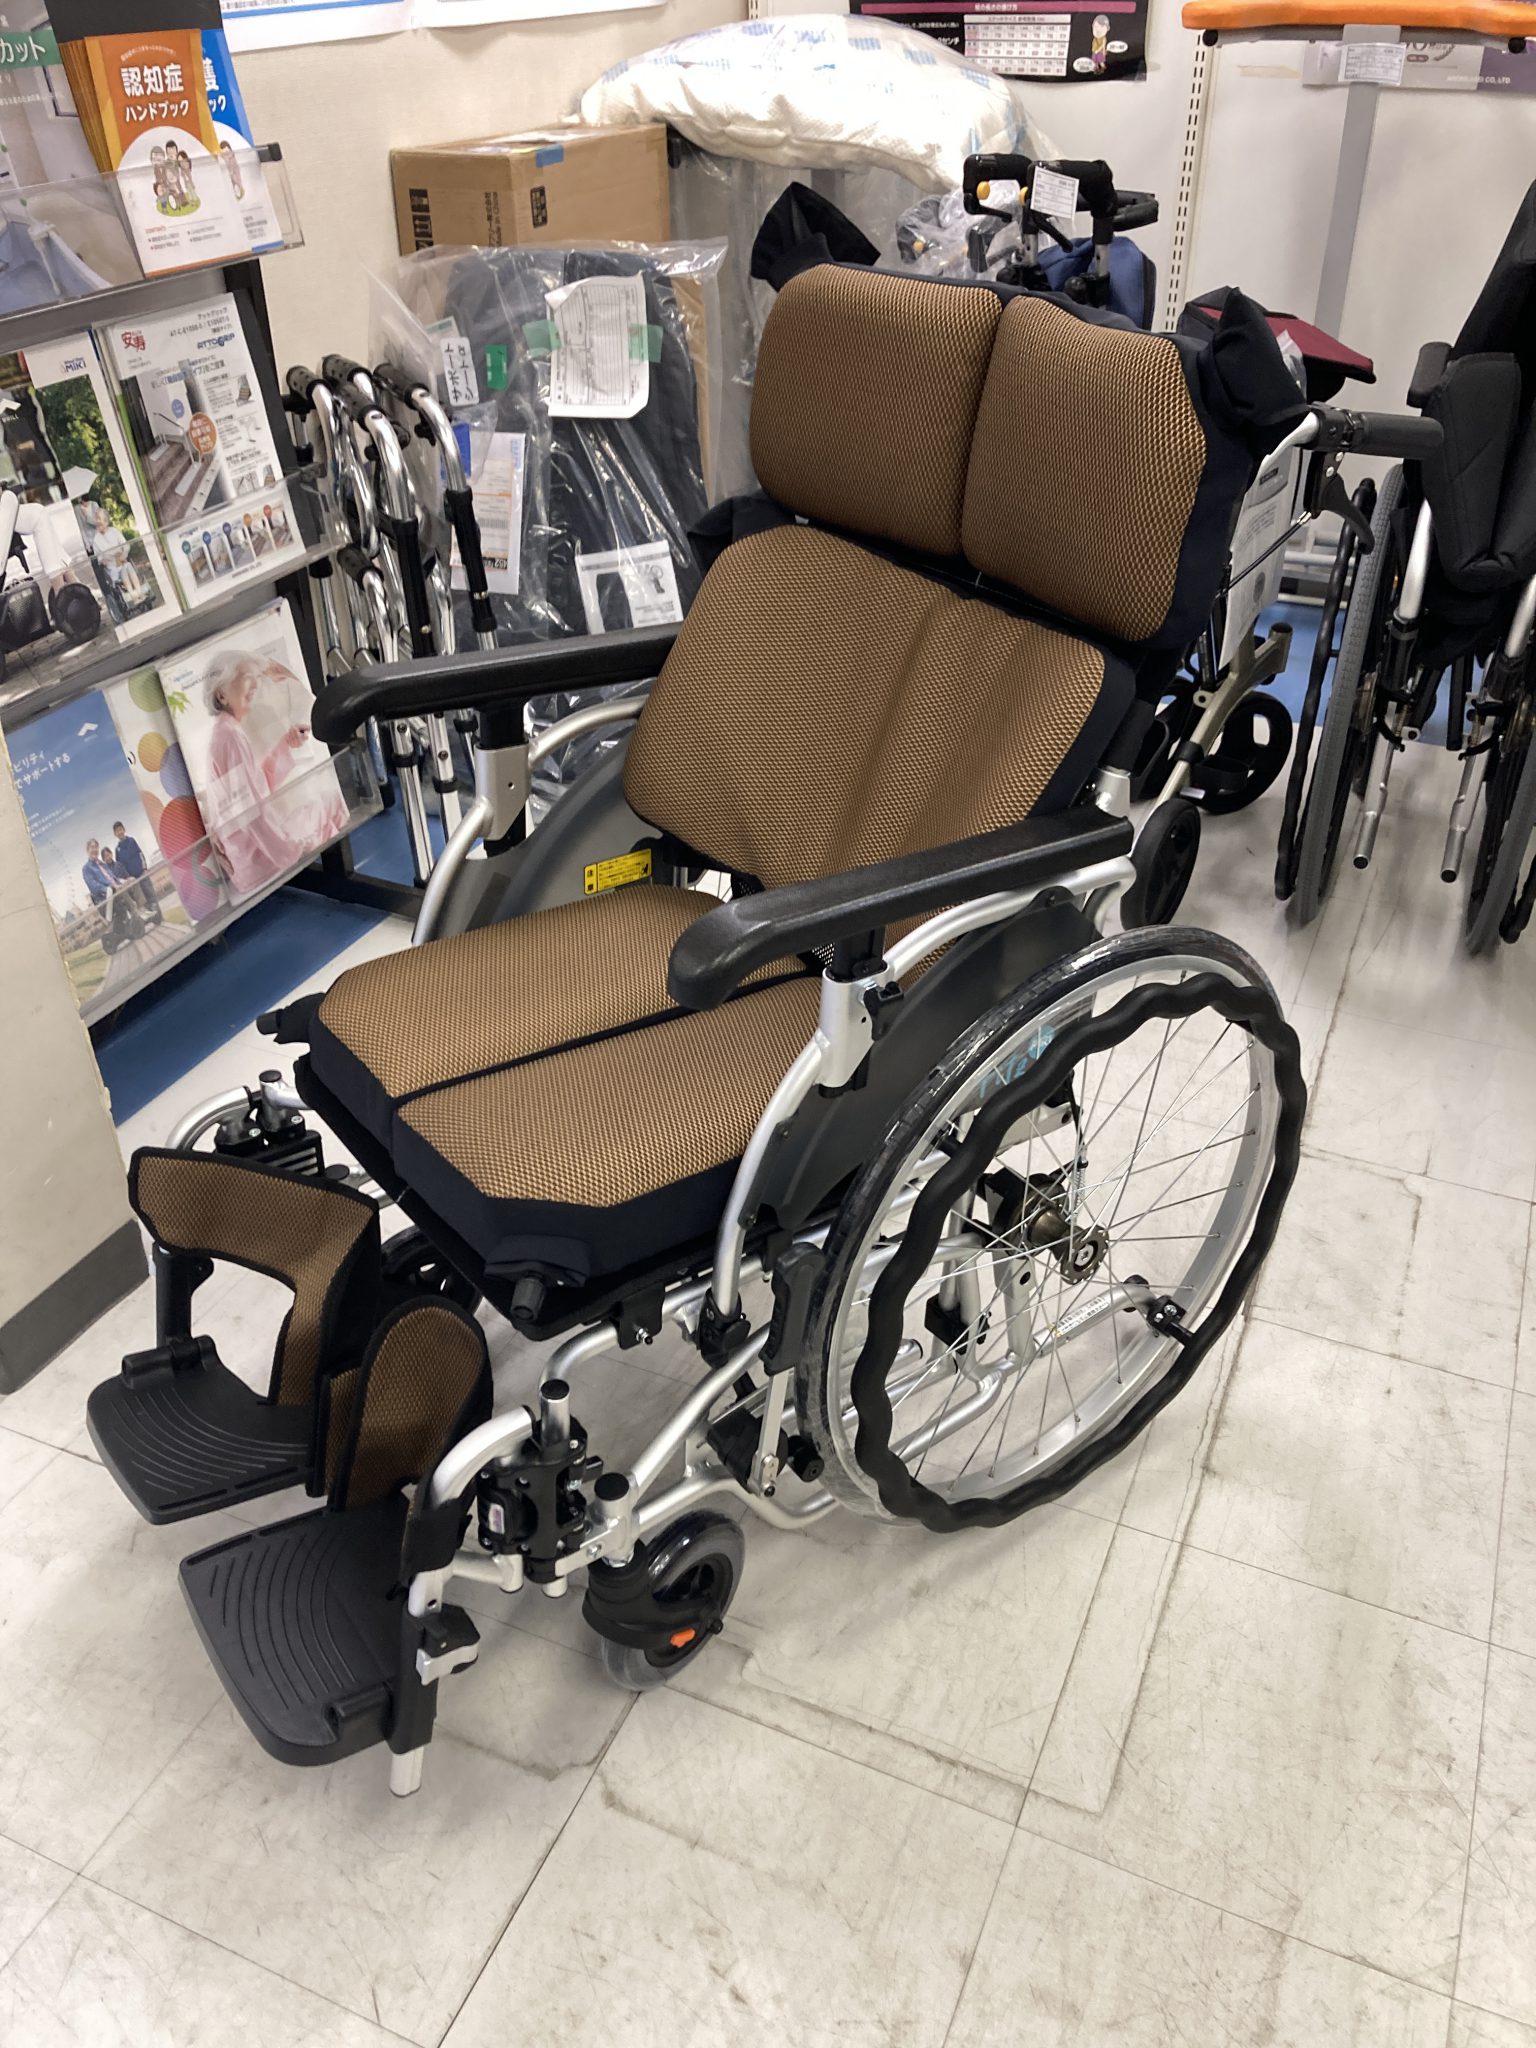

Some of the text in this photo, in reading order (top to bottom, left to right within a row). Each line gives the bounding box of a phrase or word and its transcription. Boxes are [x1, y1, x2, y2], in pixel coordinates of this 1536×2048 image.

[120, 62, 185, 97] 認知症
[125, 99, 189, 123] ハンドブック
[120, 330, 146, 352] 安寿
